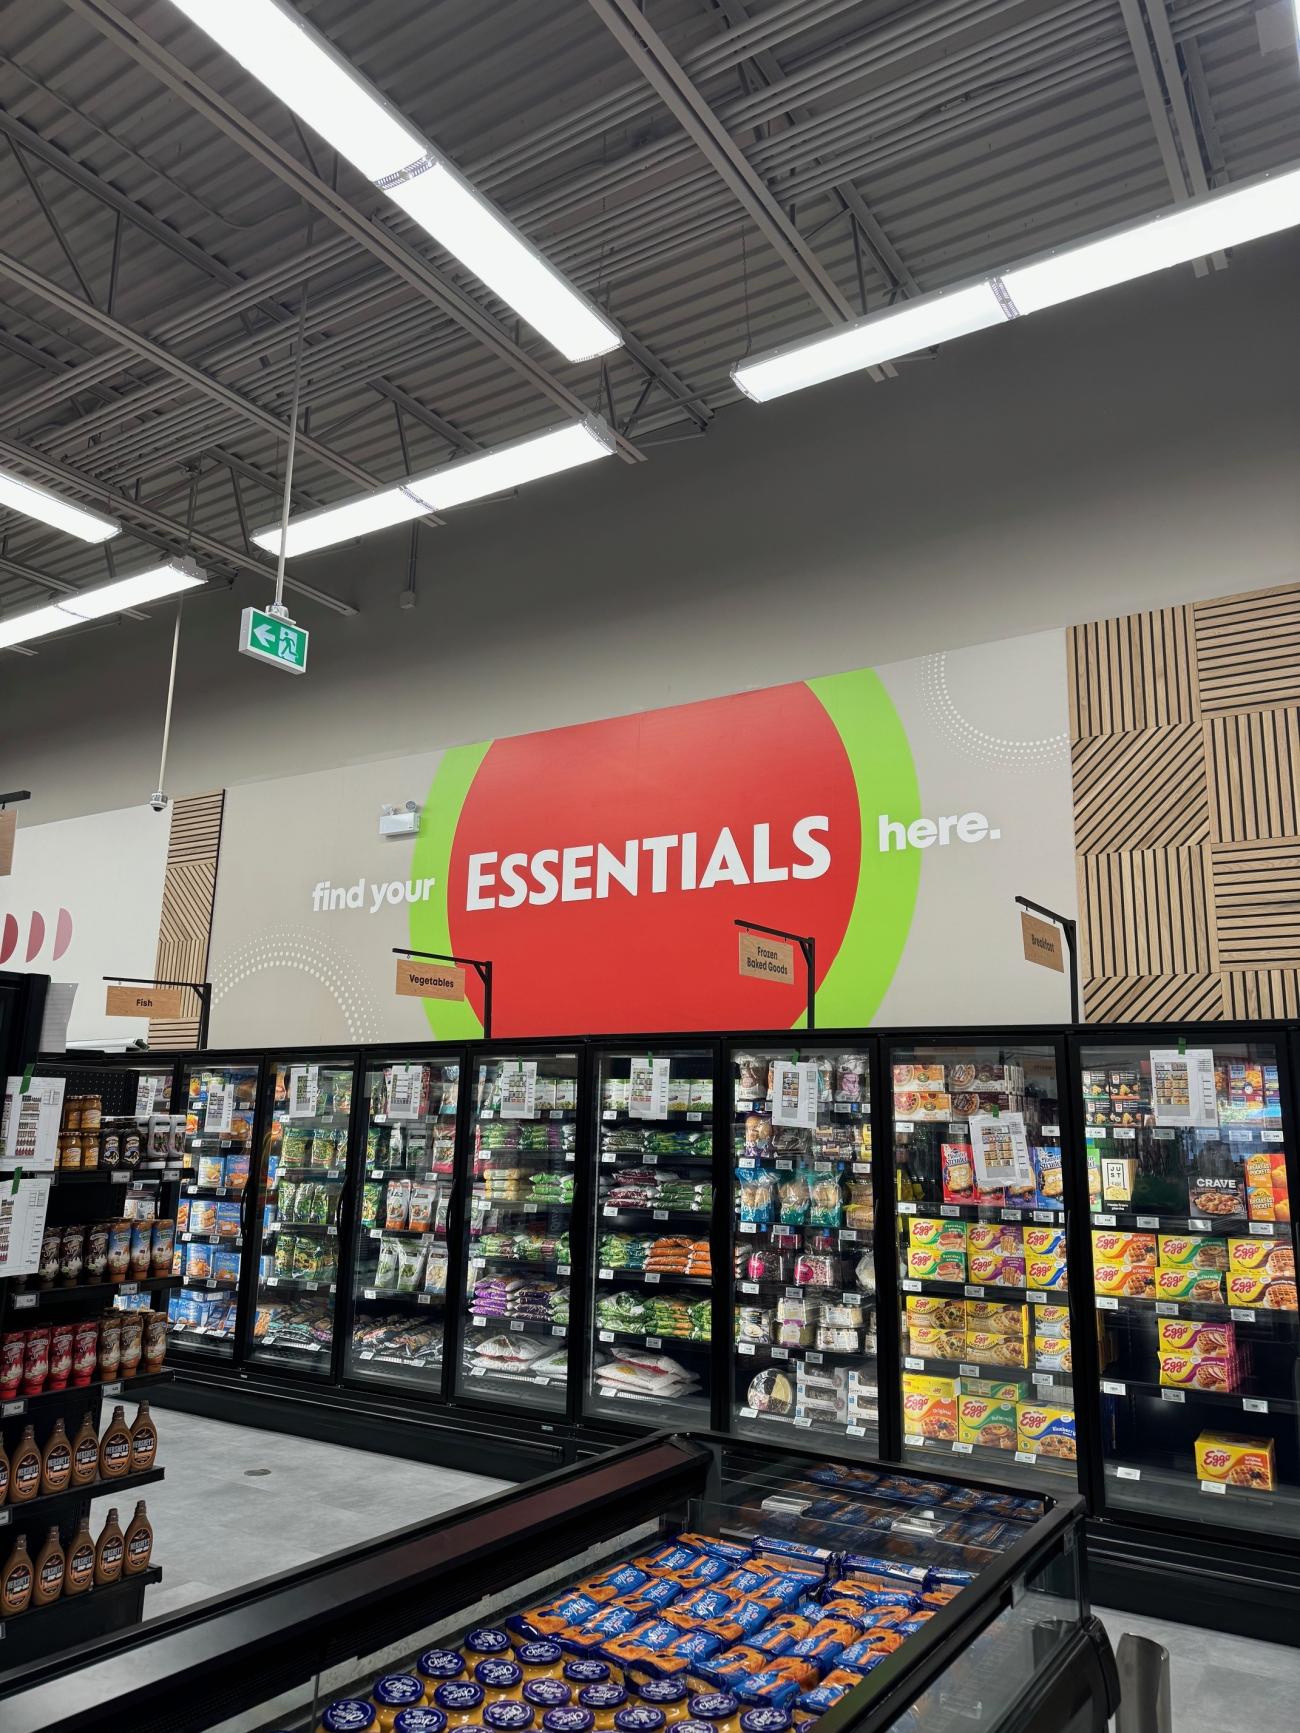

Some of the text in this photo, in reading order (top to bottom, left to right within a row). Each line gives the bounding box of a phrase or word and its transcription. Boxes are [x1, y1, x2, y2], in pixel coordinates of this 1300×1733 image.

[312, 811, 1001, 913] find your ESSENTIALS here.
[757, 946, 778, 960] Frozen
[747, 957, 788, 975] Baked Goods
[409, 974, 454, 988] Vegetables
[136, 999, 153, 1007] Fish
[1196, 1178, 1237, 1188] CRAVE
[912, 1222, 934, 1236] Eggo
[969, 1227, 991, 1241] Eggo
[1027, 1232, 1049, 1246] Eggo
[1096, 1235, 1120, 1249] Eggo
[1163, 1240, 1188, 1254] Eggo
[1233, 1244, 1260, 1259] Eggo
[911, 1252, 932, 1266] Eggo
[971, 1259, 992, 1272] Eggo
[1029, 1263, 1051, 1277] Eggo
[1095, 1267, 1119, 1281] Eggo
[1159, 1272, 1184, 1287] Eggo
[1231, 1278, 1257, 1293] Eggo
[1163, 1324, 1188, 1339] Eggo
[1162, 1357, 1188, 1373] Eggo
[904, 1394, 929, 1410] Eggo
[962, 1401, 988, 1417] Eggo
[1020, 1411, 1047, 1428] Eggo
[1204, 1450, 1232, 1467] Eggo
